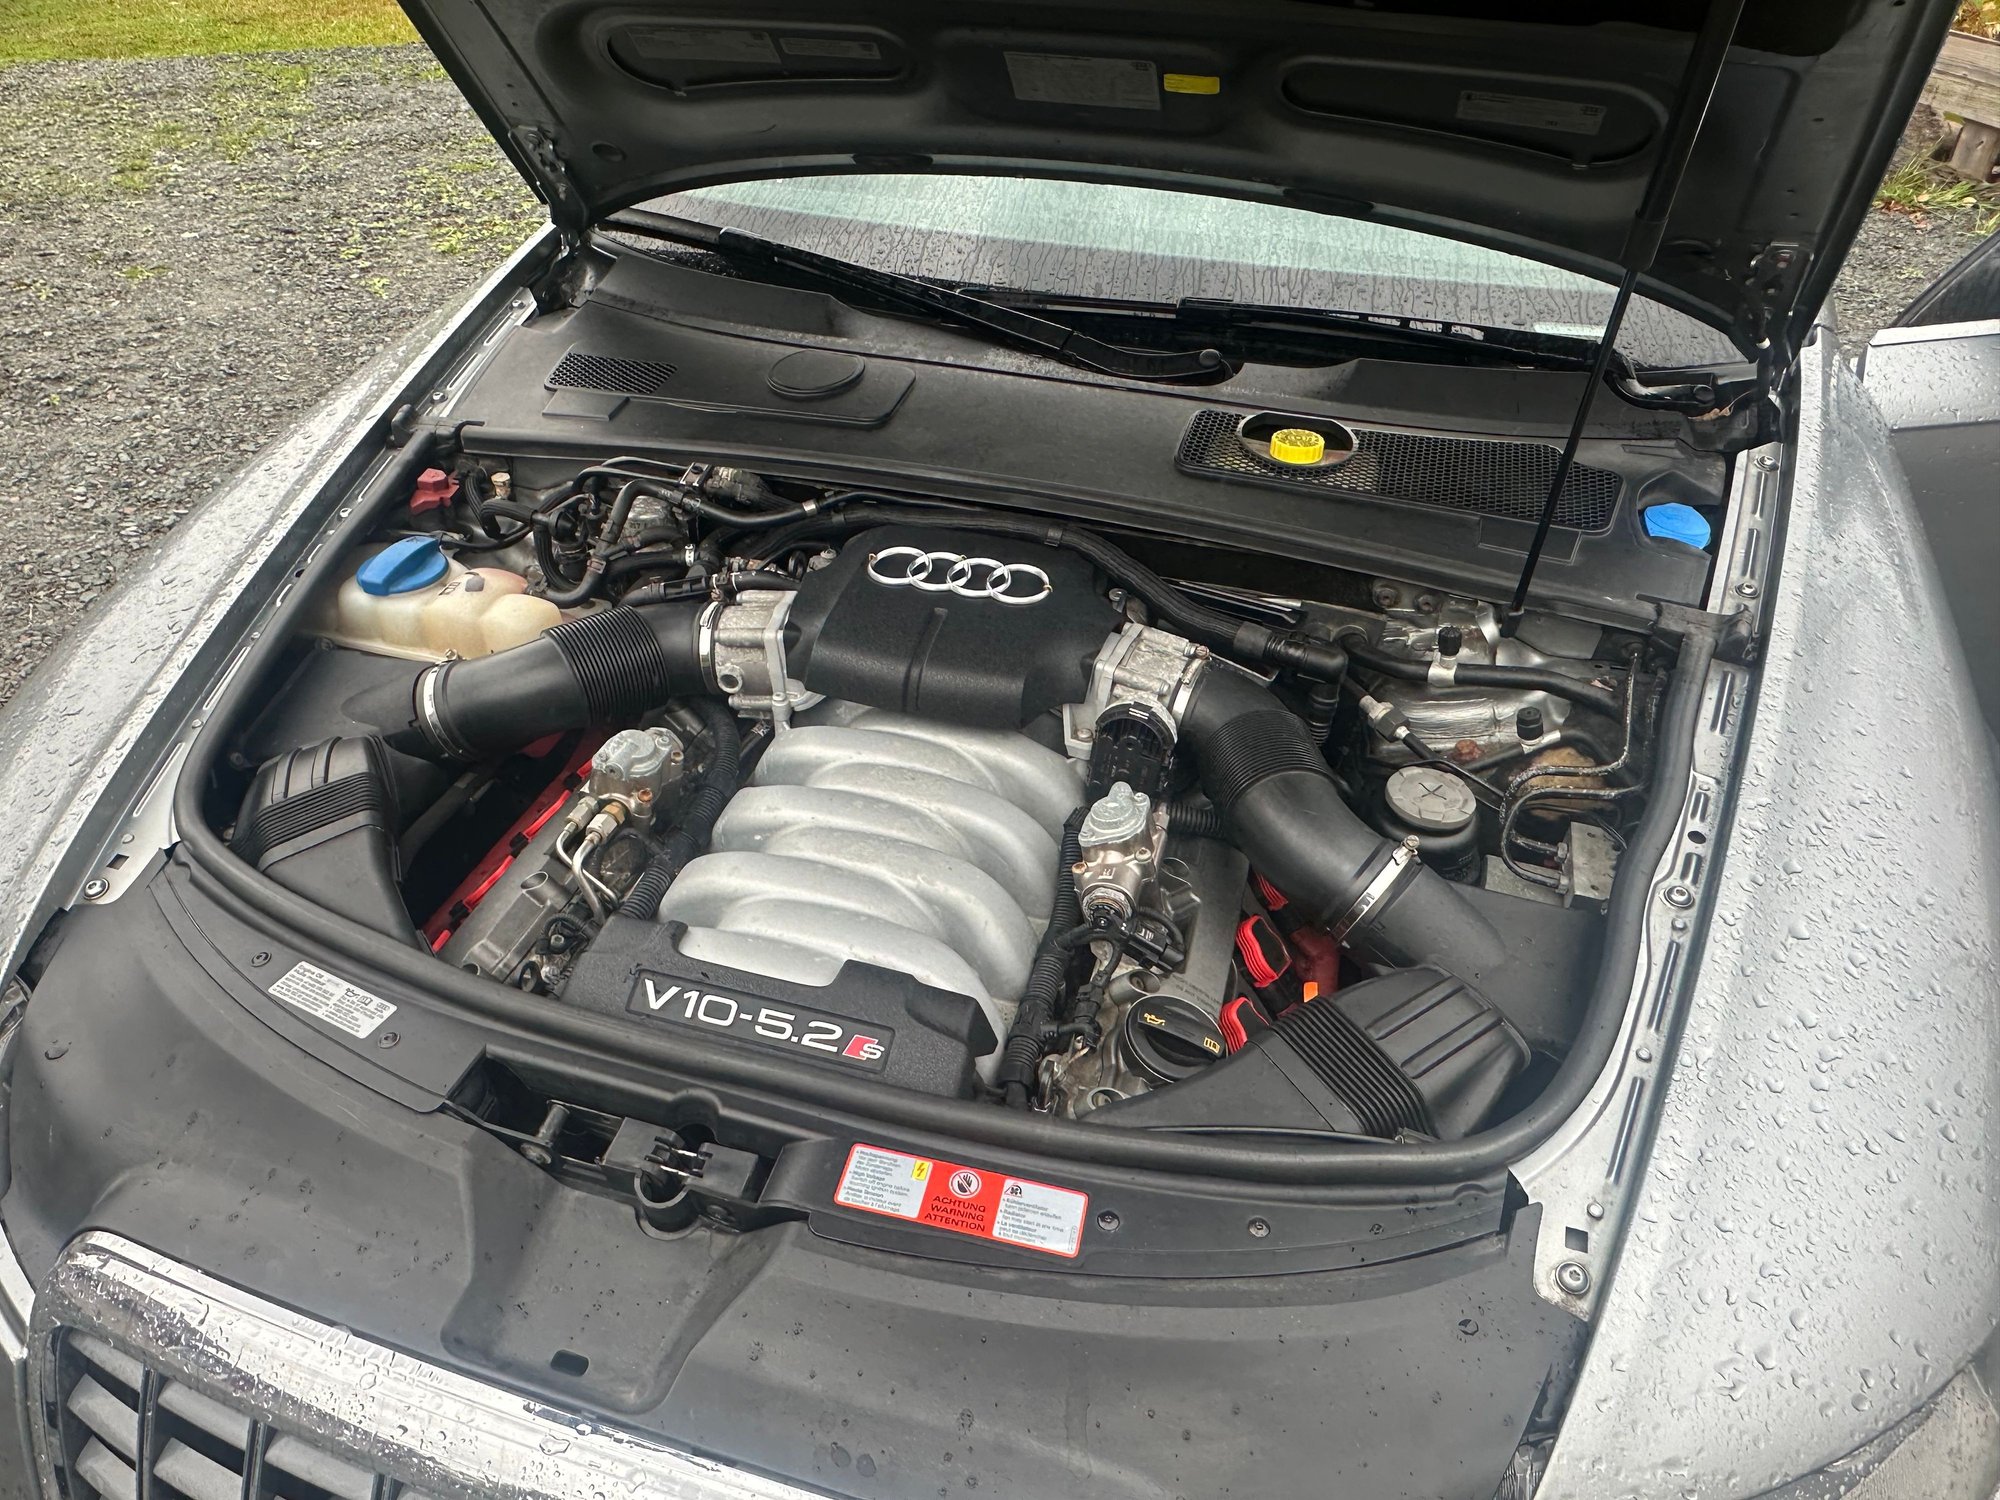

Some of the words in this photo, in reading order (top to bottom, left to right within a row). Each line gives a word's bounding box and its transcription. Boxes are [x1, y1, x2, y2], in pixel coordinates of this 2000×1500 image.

[644, 979, 843, 1052] V10-5.2
[931, 1203, 984, 1221] WARNING
[933, 1196, 986, 1212] ACHTUNG
[925, 1213, 985, 1231] ATTENTION
